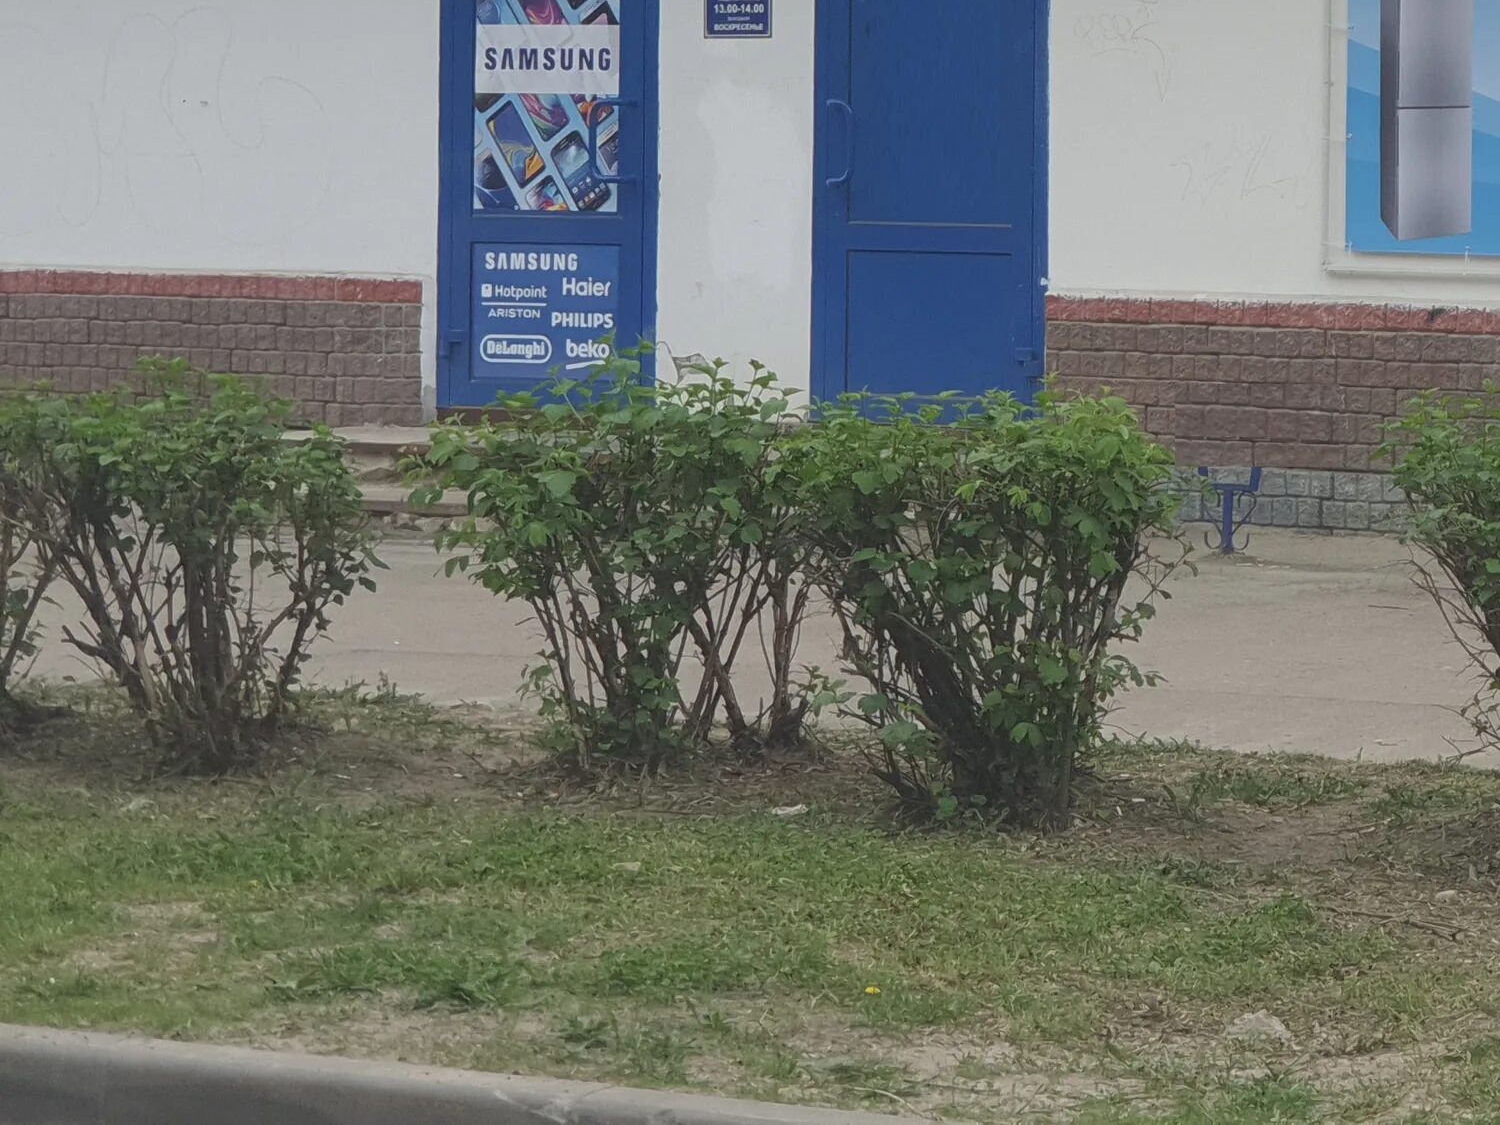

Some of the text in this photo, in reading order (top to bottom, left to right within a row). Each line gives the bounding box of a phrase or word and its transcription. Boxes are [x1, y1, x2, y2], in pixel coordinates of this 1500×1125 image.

[714, 3, 764, 13] 13.00-14.00
[484, 47, 612, 71] SAMSUNG
[485, 252, 578, 271] SAMSUNG
[495, 285, 547, 300] Hotpoint
[562, 277, 611, 296] Haier
[488, 308, 541, 318] ARISTON
[551, 312, 614, 328] PHILIPS
[565, 339, 610, 358] beko
